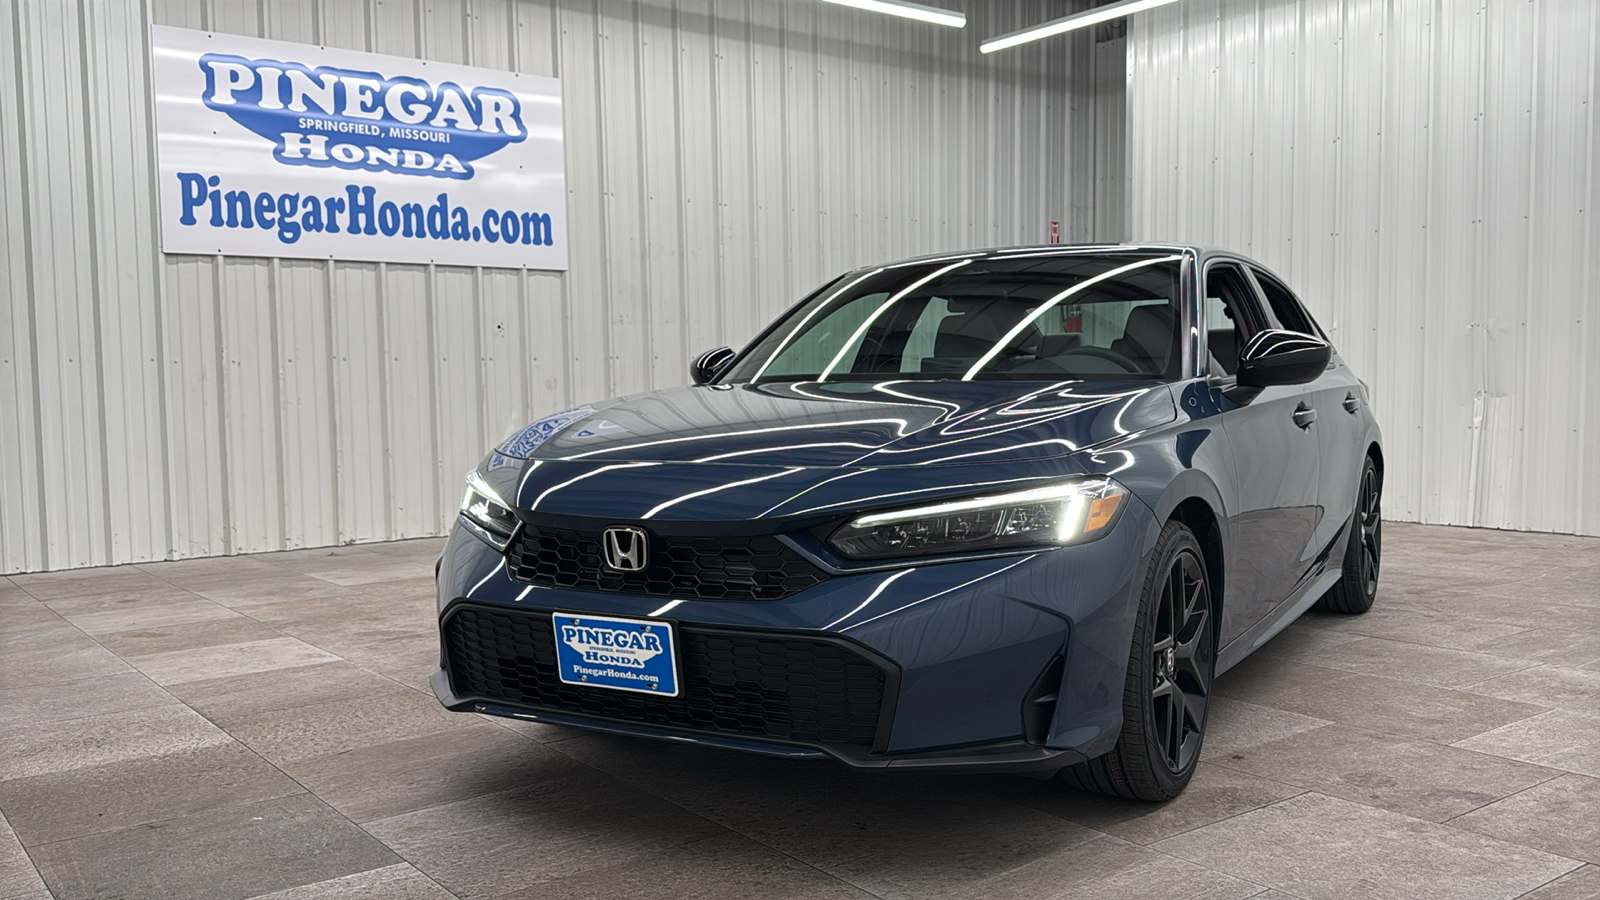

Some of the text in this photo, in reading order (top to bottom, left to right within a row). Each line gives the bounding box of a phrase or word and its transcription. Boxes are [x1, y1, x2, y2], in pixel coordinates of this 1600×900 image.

[206, 61, 523, 137] PINEGAR
[298, 117, 451, 144] SPRINGFIELD, MISSOURI
[280, 132, 468, 174] HONDA
[176, 172, 554, 247] PinegarHonda.com
[563, 627, 660, 652] PINEGAR
[585, 651, 643, 666] HONDA
[572, 664, 659, 683] PinegarHonda.com
